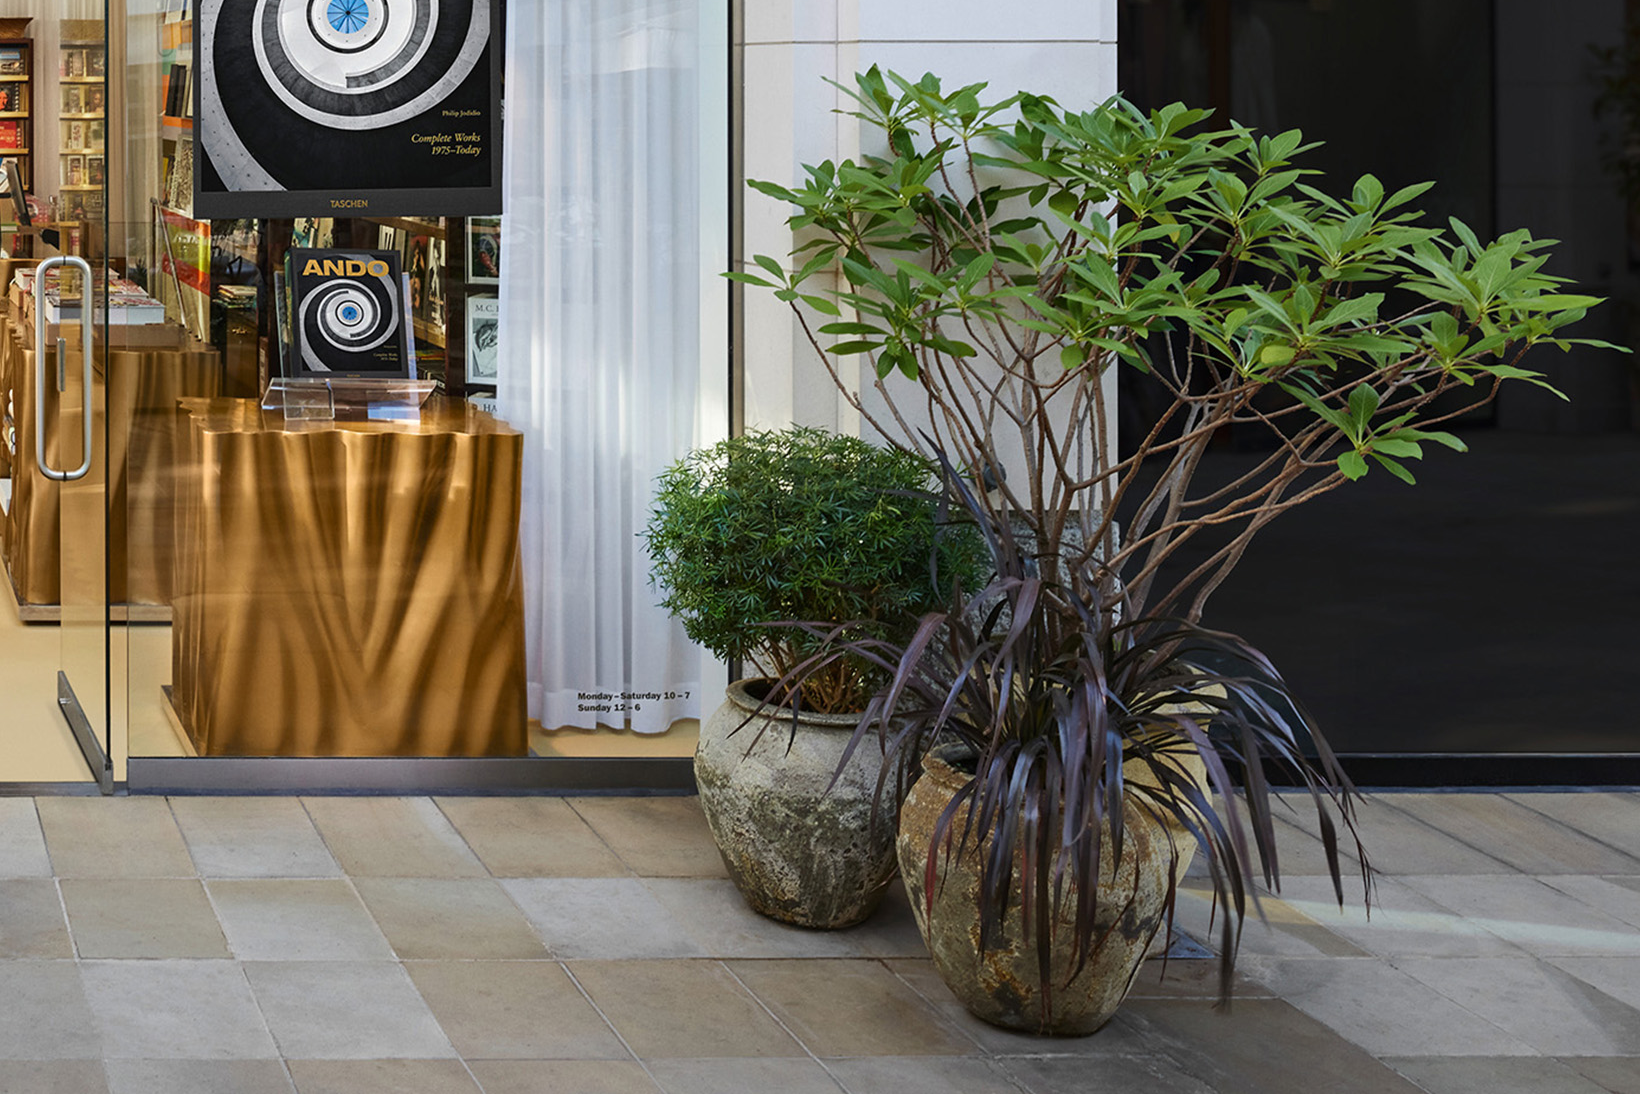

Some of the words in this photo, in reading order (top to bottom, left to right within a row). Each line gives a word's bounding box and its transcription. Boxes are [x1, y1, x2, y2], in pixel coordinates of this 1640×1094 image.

[411, 132, 452, 145] Complete
[455, 132, 481, 142] Works
[330, 199, 368, 208] TASCHEN
[302, 259, 390, 277] ANDO
[475, 303, 494, 313] M.C.
[577, 692, 613, 701] Monday
[620, 691, 662, 701] Saturday
[664, 691, 676, 700] 10
[685, 691, 691, 699] 7
[577, 704, 612, 713] Sunday
[614, 704, 626, 712] 12
[634, 704, 641, 712] 6
